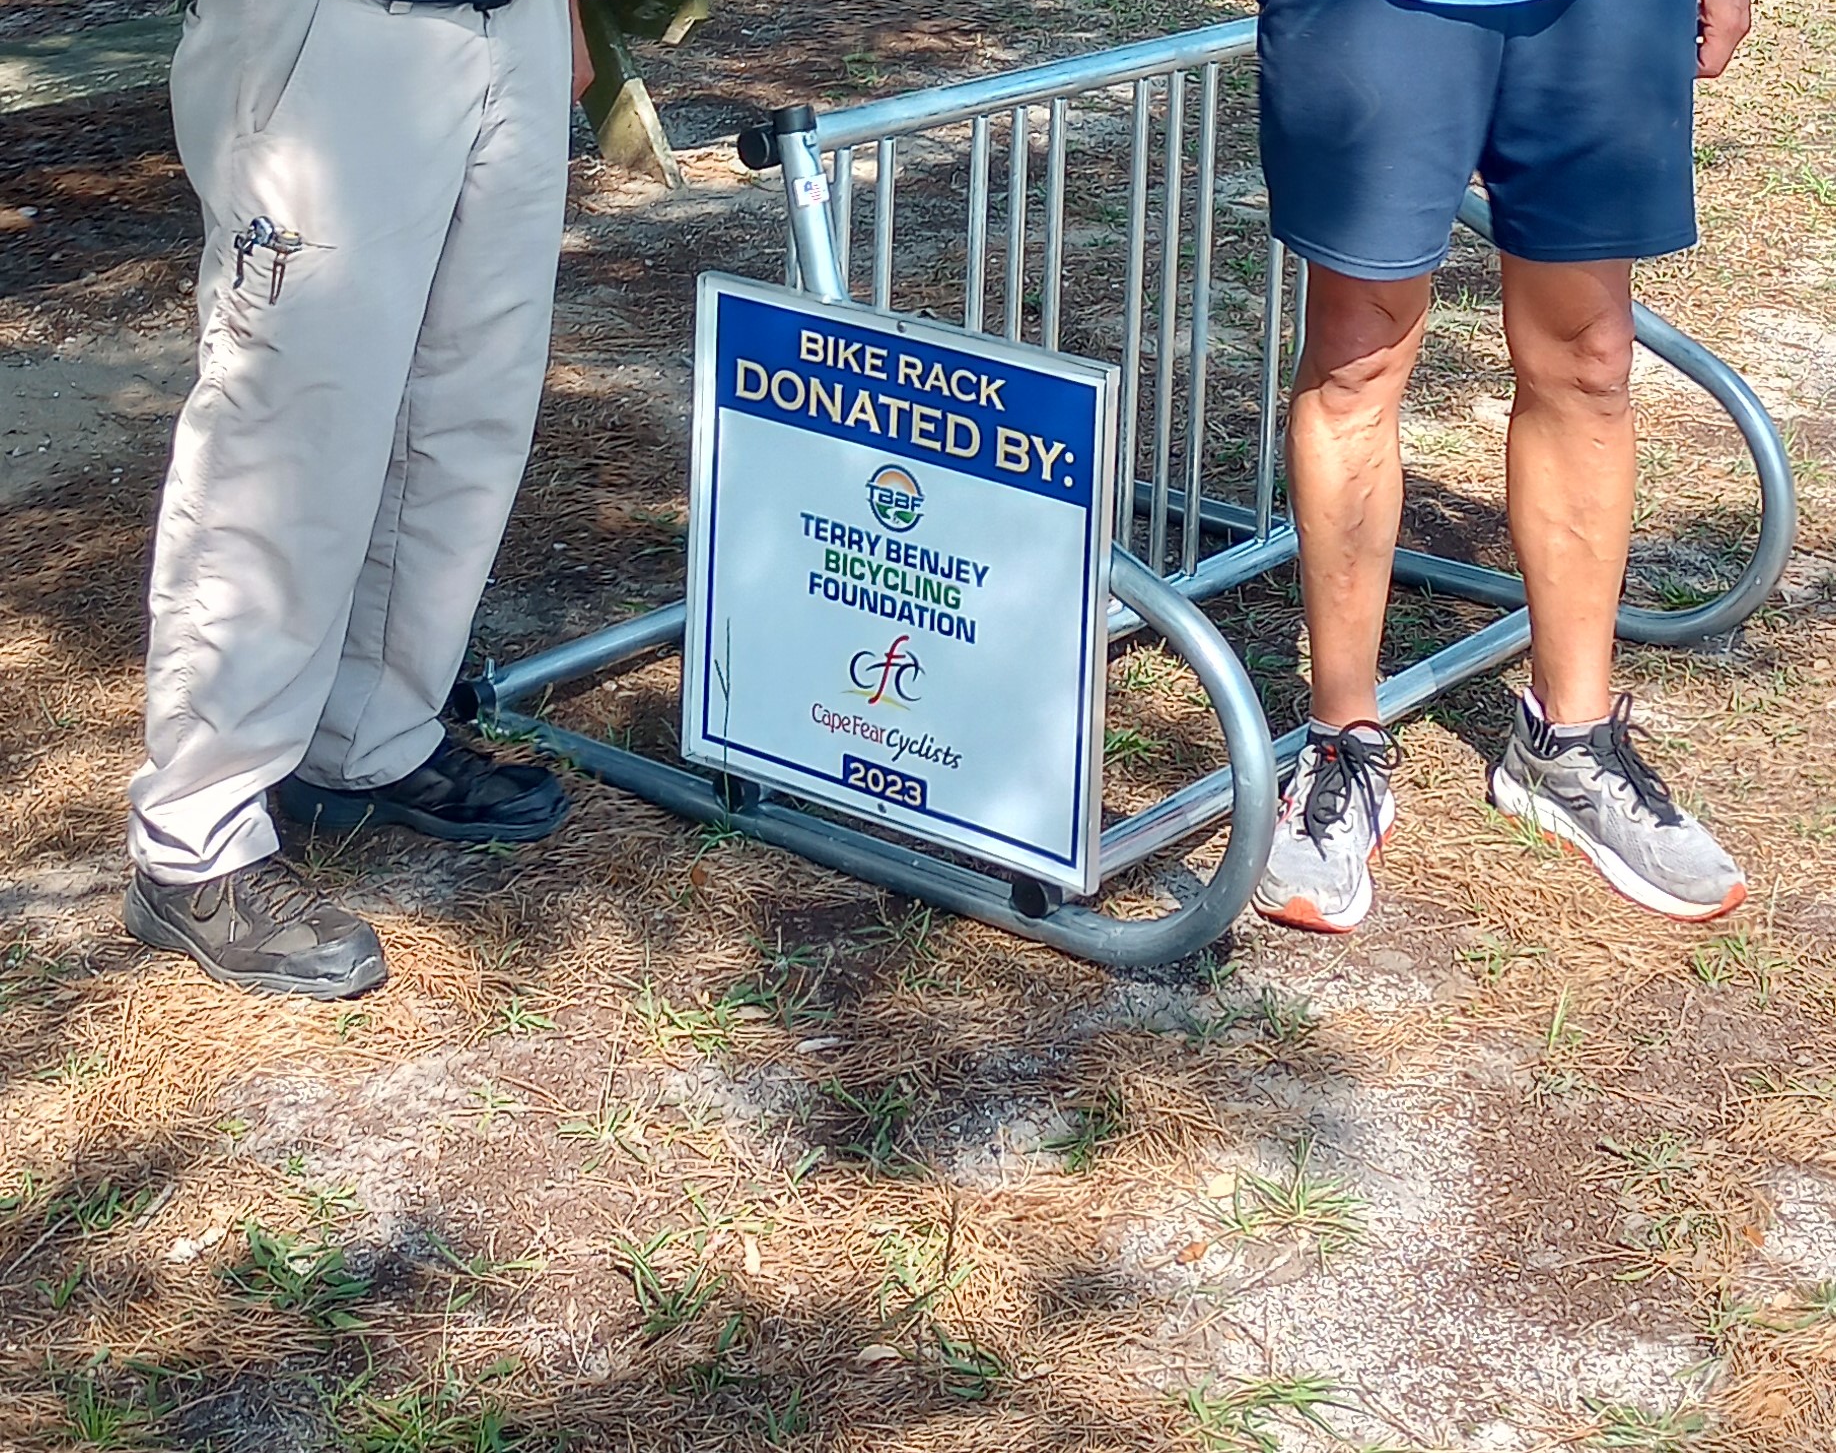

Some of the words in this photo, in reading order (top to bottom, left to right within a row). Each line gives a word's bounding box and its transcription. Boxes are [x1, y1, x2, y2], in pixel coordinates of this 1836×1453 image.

[800, 329, 888, 380] BIKE
[897, 353, 1006, 412] RACK
[735, 358, 981, 458] DONATED
[995, 426, 1074, 487] BY:
[866, 483, 925, 512] TBBF
[800, 512, 882, 557] TERRY
[885, 538, 990, 588] BENJEY
[824, 548, 962, 610] BICYCLING
[808, 572, 976, 645] FOUNDATION
[847, 761, 922, 807] 2023
